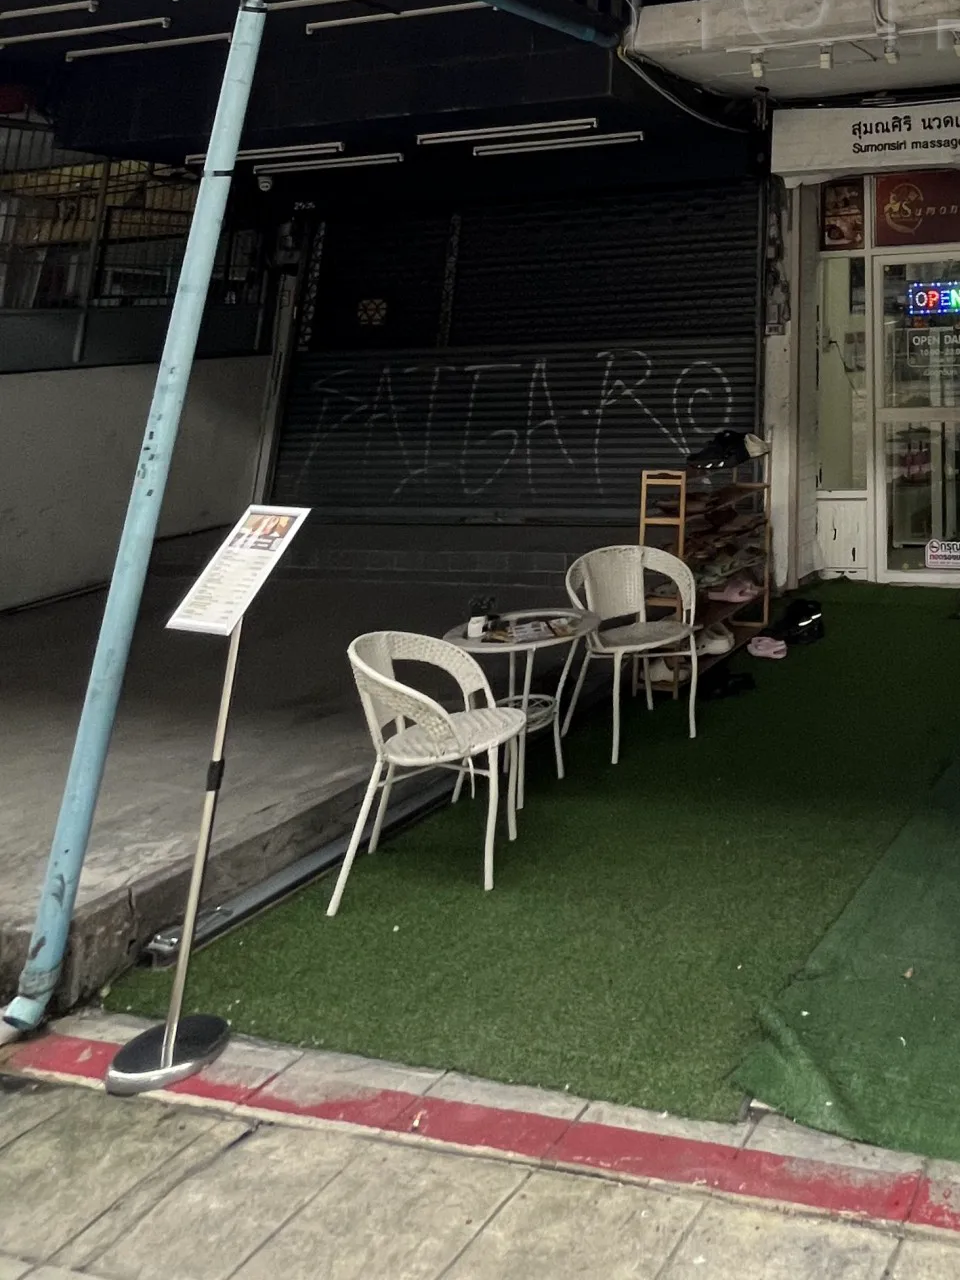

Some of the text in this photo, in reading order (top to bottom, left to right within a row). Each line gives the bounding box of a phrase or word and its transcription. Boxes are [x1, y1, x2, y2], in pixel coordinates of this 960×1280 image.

[851, 115, 912, 140] สุมณศิริ
[852, 139, 907, 154] Sumonsiri
[912, 335, 939, 346] OPEN
